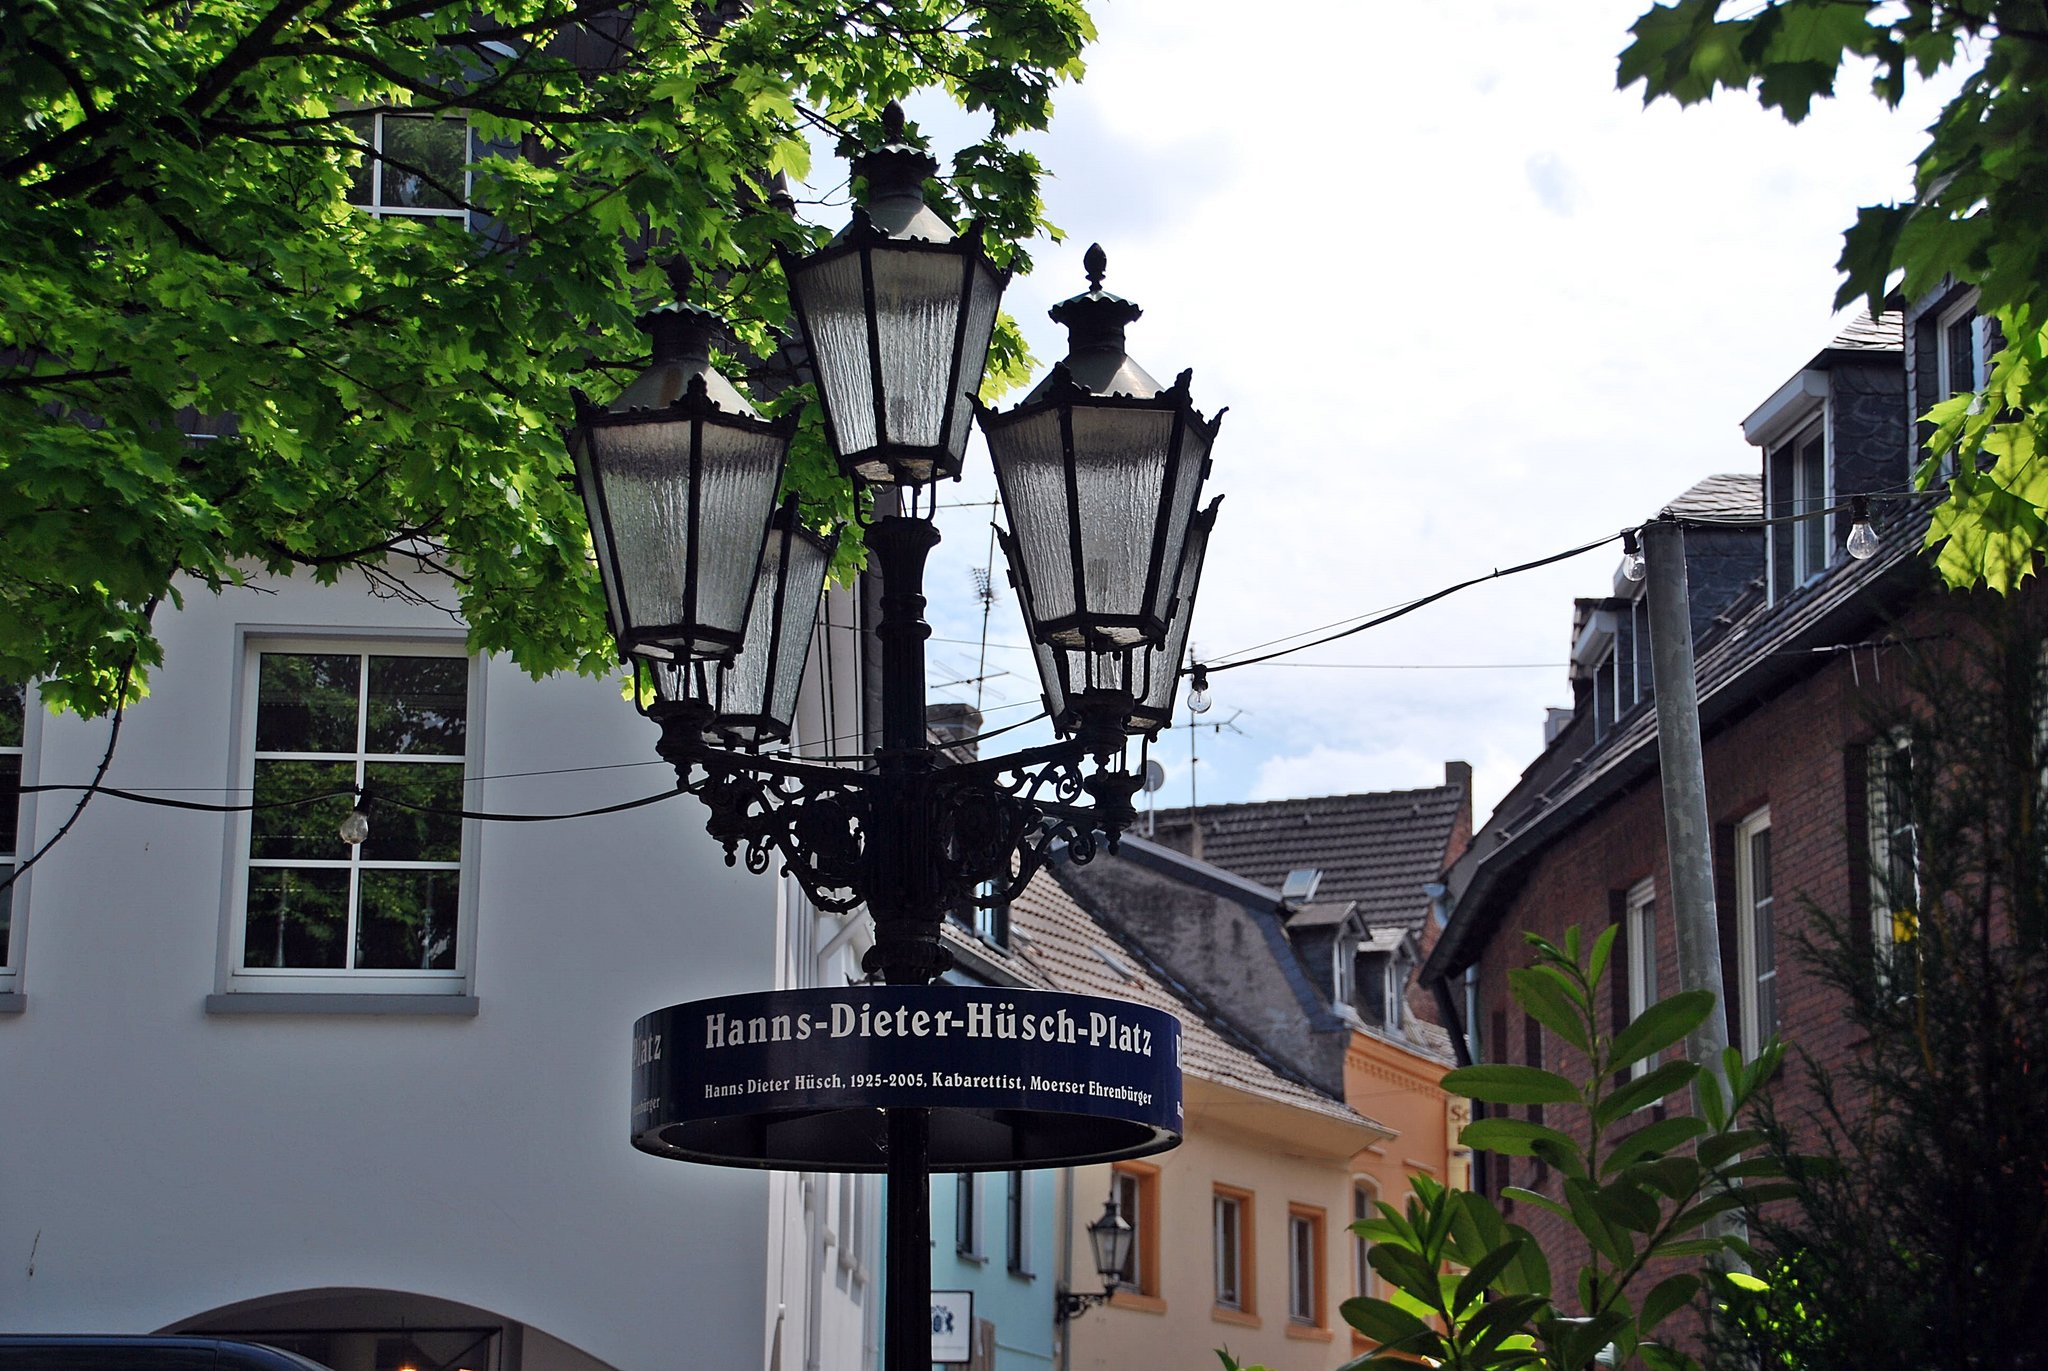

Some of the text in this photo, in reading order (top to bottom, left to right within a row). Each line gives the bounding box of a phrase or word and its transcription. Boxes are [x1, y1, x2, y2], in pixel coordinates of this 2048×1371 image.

[705, 1002, 1152, 1058] Hanns-Dieter-Hüsch-Platz
[704, 1072, 1152, 1107] Hanns Dieter Hüsch, 1925-2005, Kabarettist, Moerser Ehrenbürger
